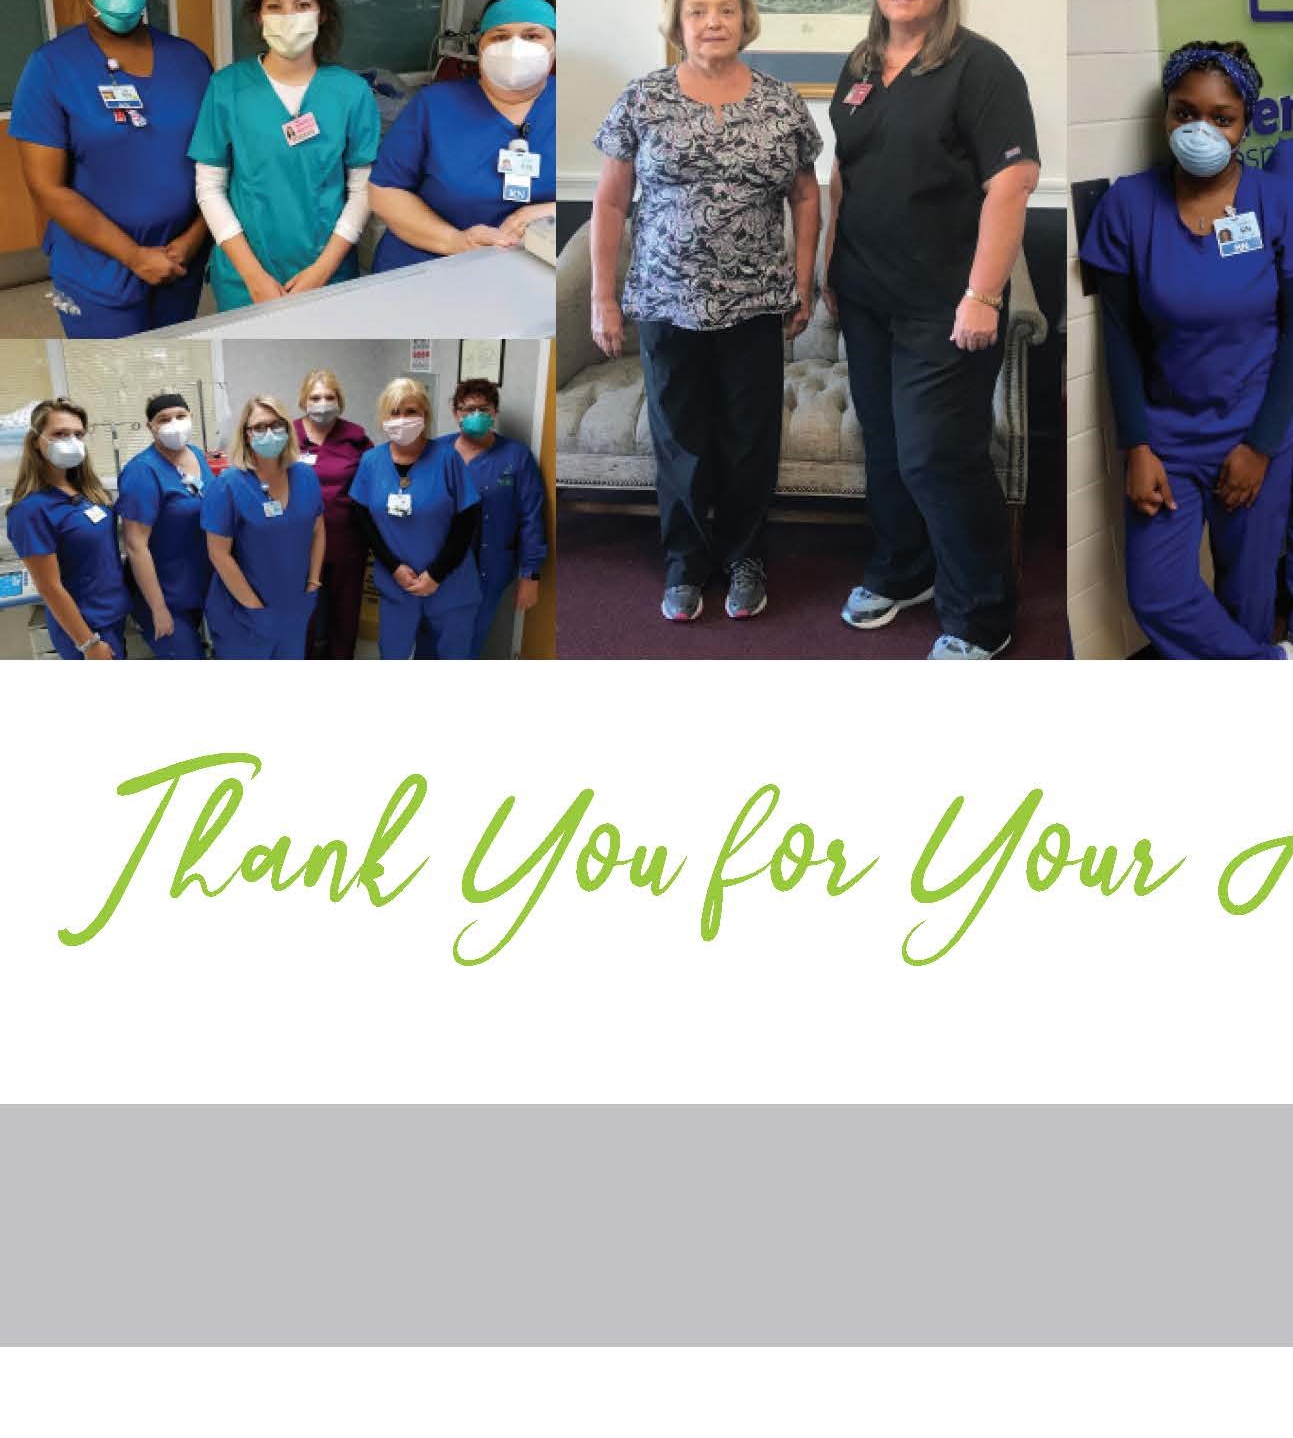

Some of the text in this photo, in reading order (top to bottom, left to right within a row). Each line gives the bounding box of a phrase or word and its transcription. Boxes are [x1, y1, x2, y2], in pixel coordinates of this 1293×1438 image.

[58, 753, 430, 946] Thank
[453, 789, 688, 966] You
[701, 784, 880, 941] for
[902, 789, 1187, 966] Your
